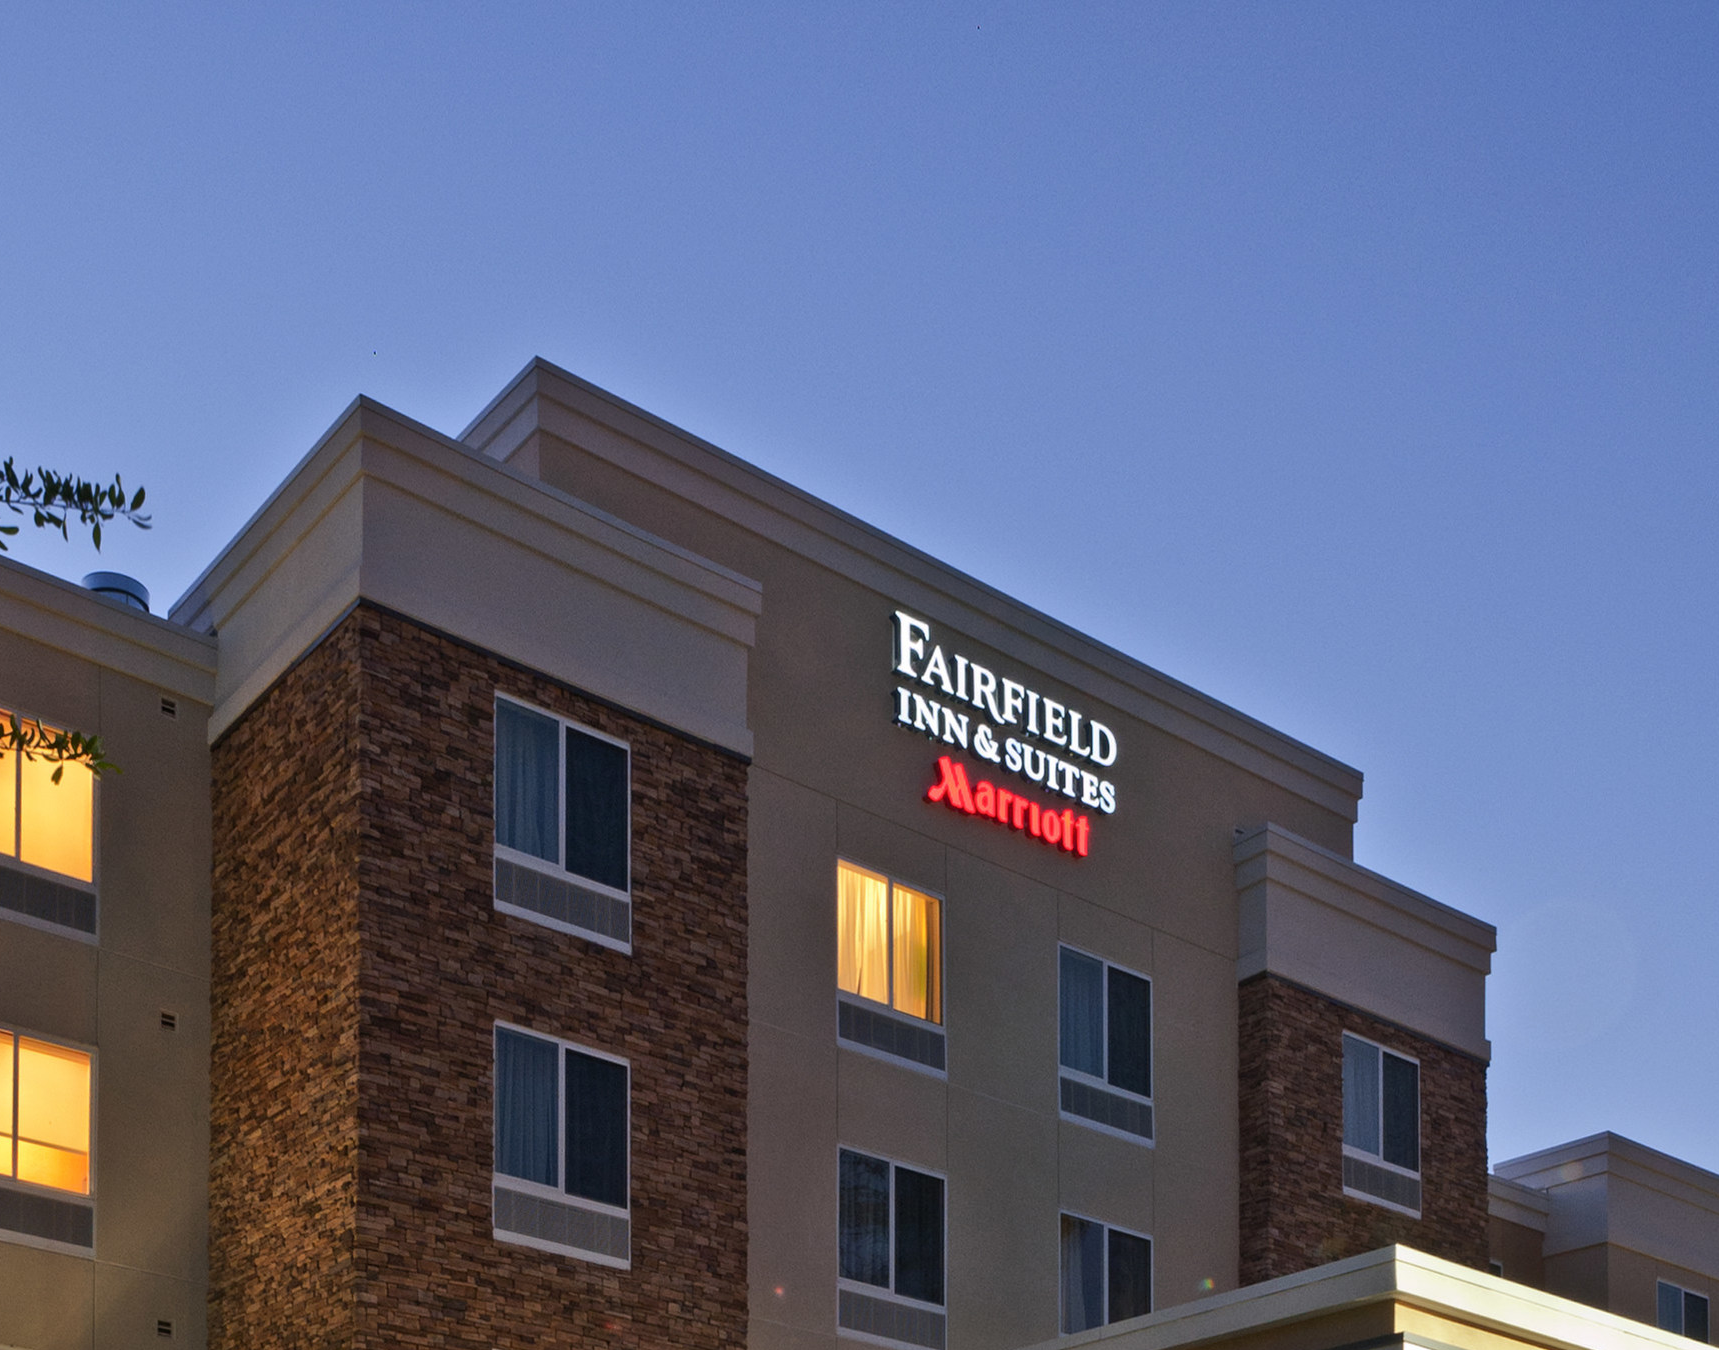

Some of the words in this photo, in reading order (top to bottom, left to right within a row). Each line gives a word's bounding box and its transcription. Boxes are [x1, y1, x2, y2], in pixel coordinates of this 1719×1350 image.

[893, 610, 1118, 767] FAIRFIELD
[896, 686, 970, 750] INN
[973, 723, 1001, 764] &
[1004, 737, 1117, 815] SUITES
[927, 755, 1091, 857] Marriott
